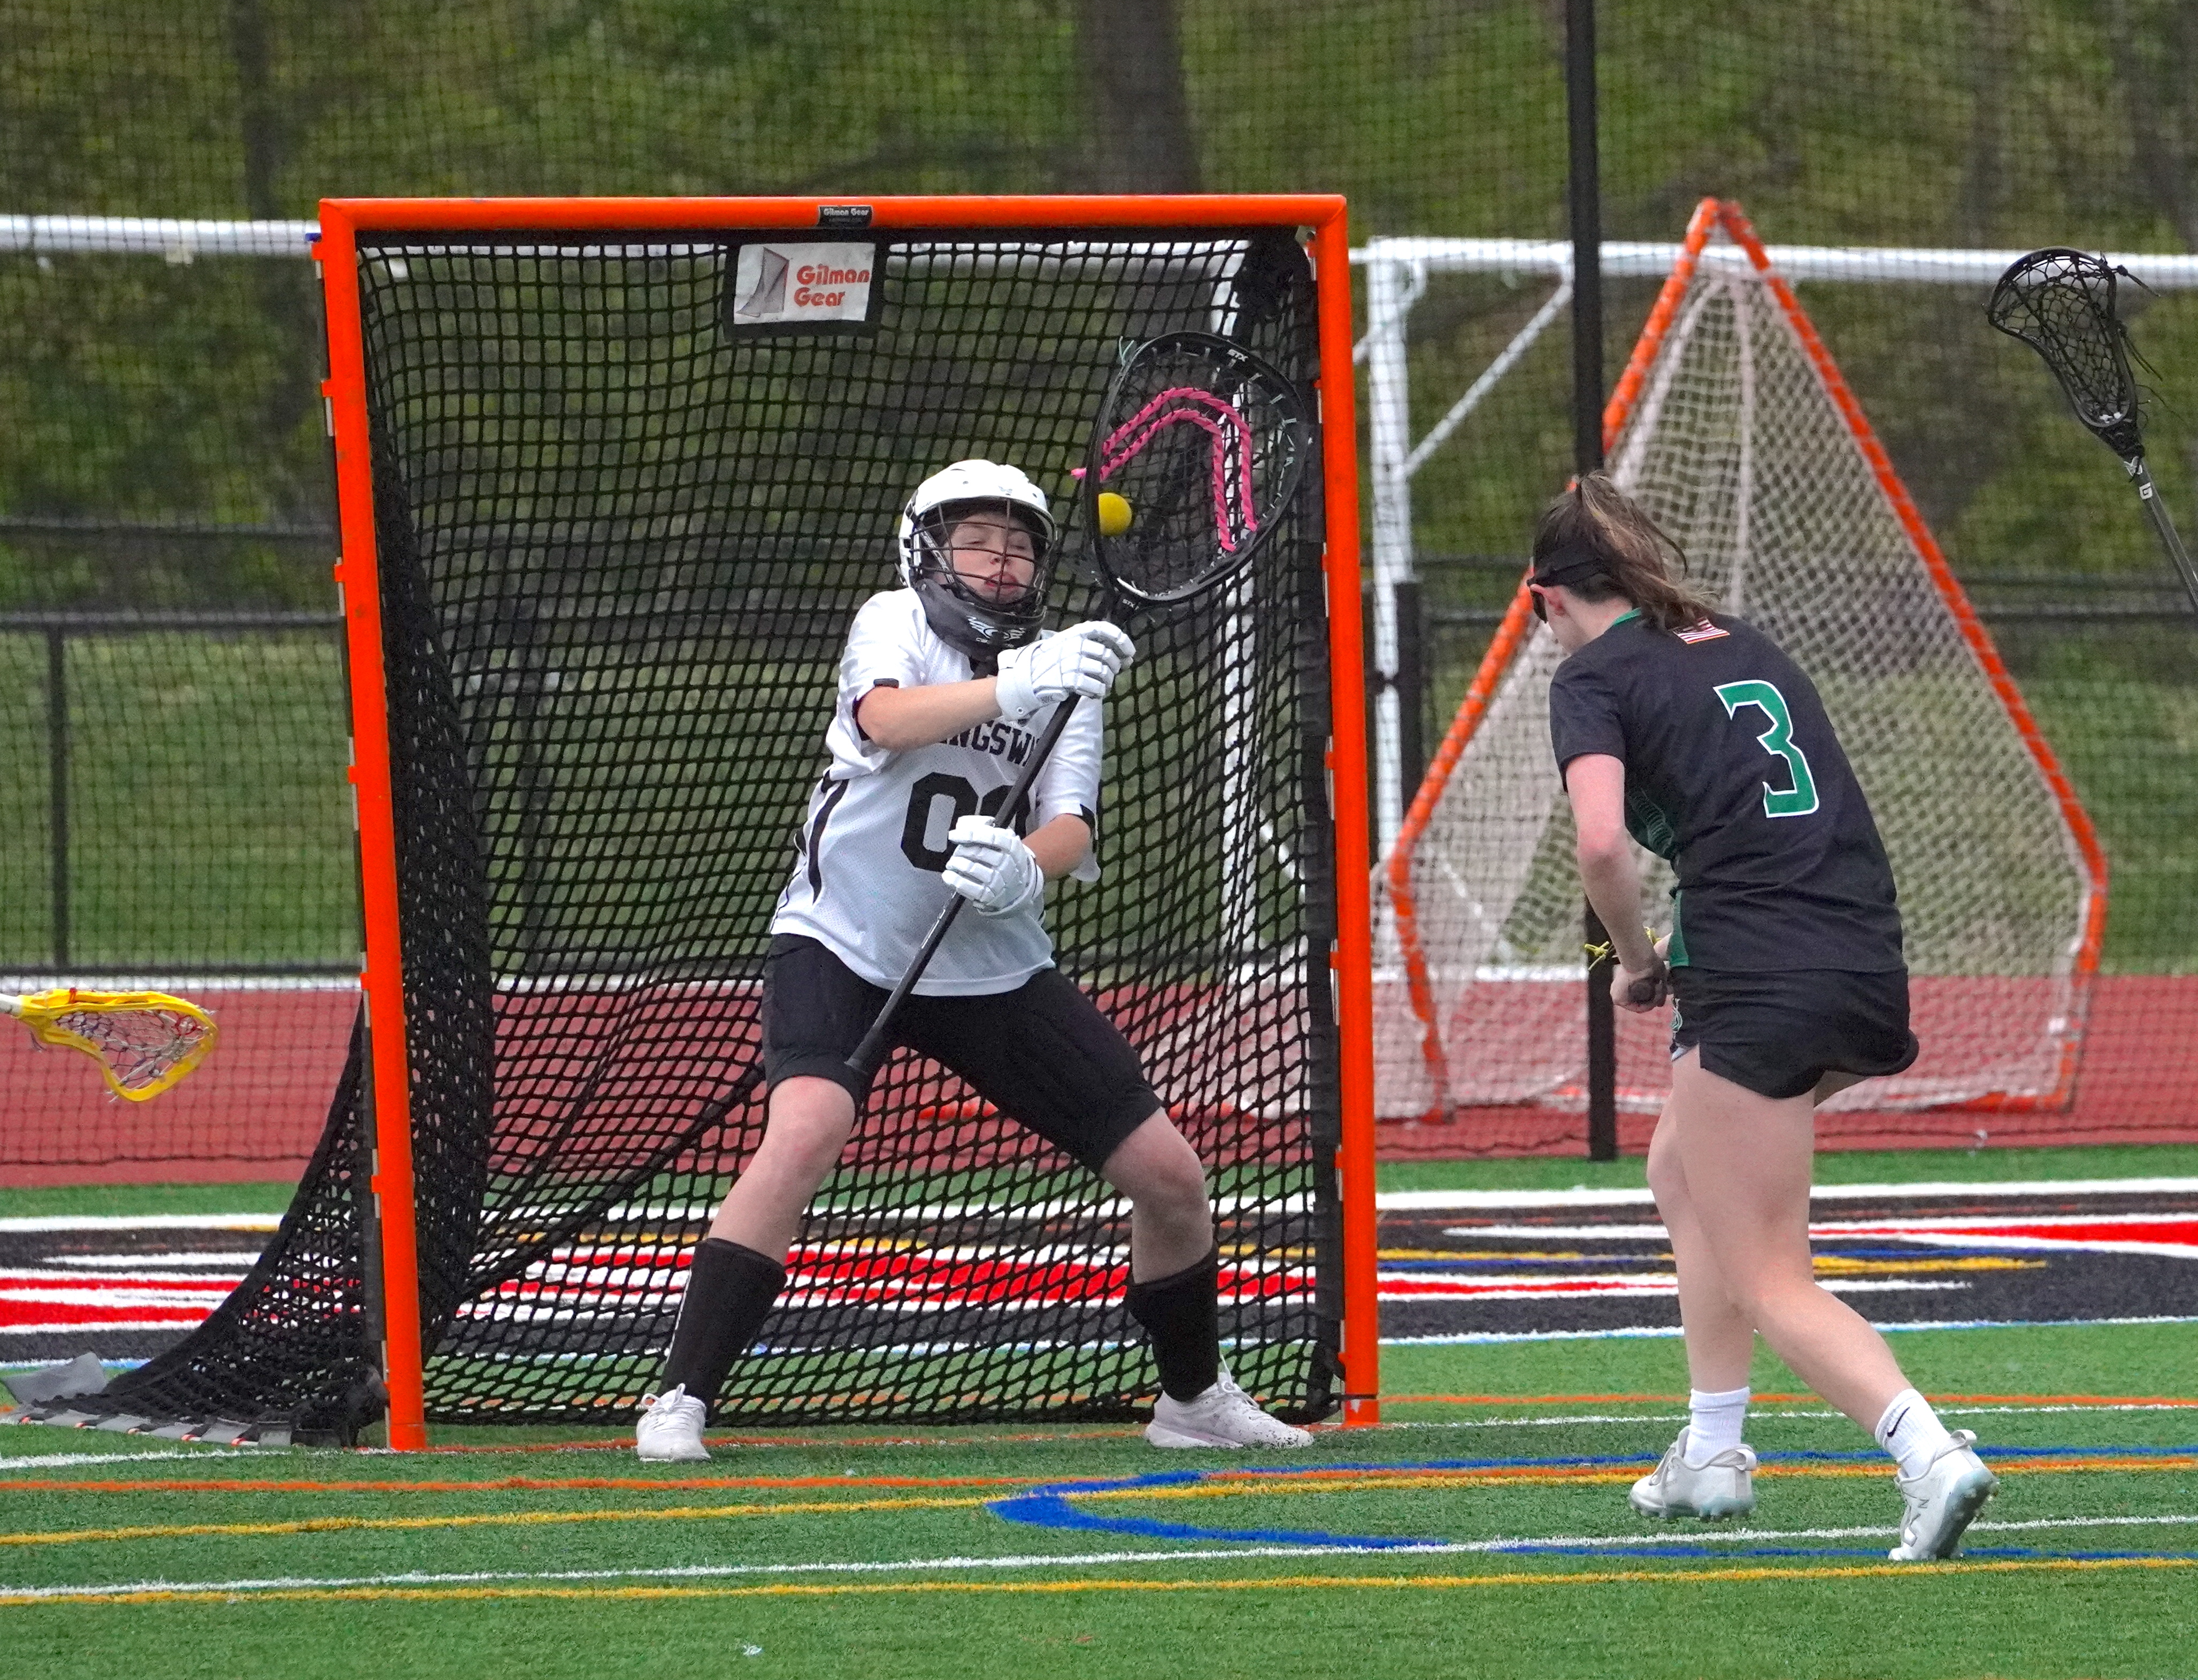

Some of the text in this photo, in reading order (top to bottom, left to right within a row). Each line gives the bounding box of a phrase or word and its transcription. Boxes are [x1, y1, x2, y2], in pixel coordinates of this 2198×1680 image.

[851, 208, 869, 216] Gear
[796, 264, 870, 285] Gilman
[794, 287, 846, 307] Gear
[1123, 599, 1135, 608] STX
[1713, 680, 1819, 818] 3
